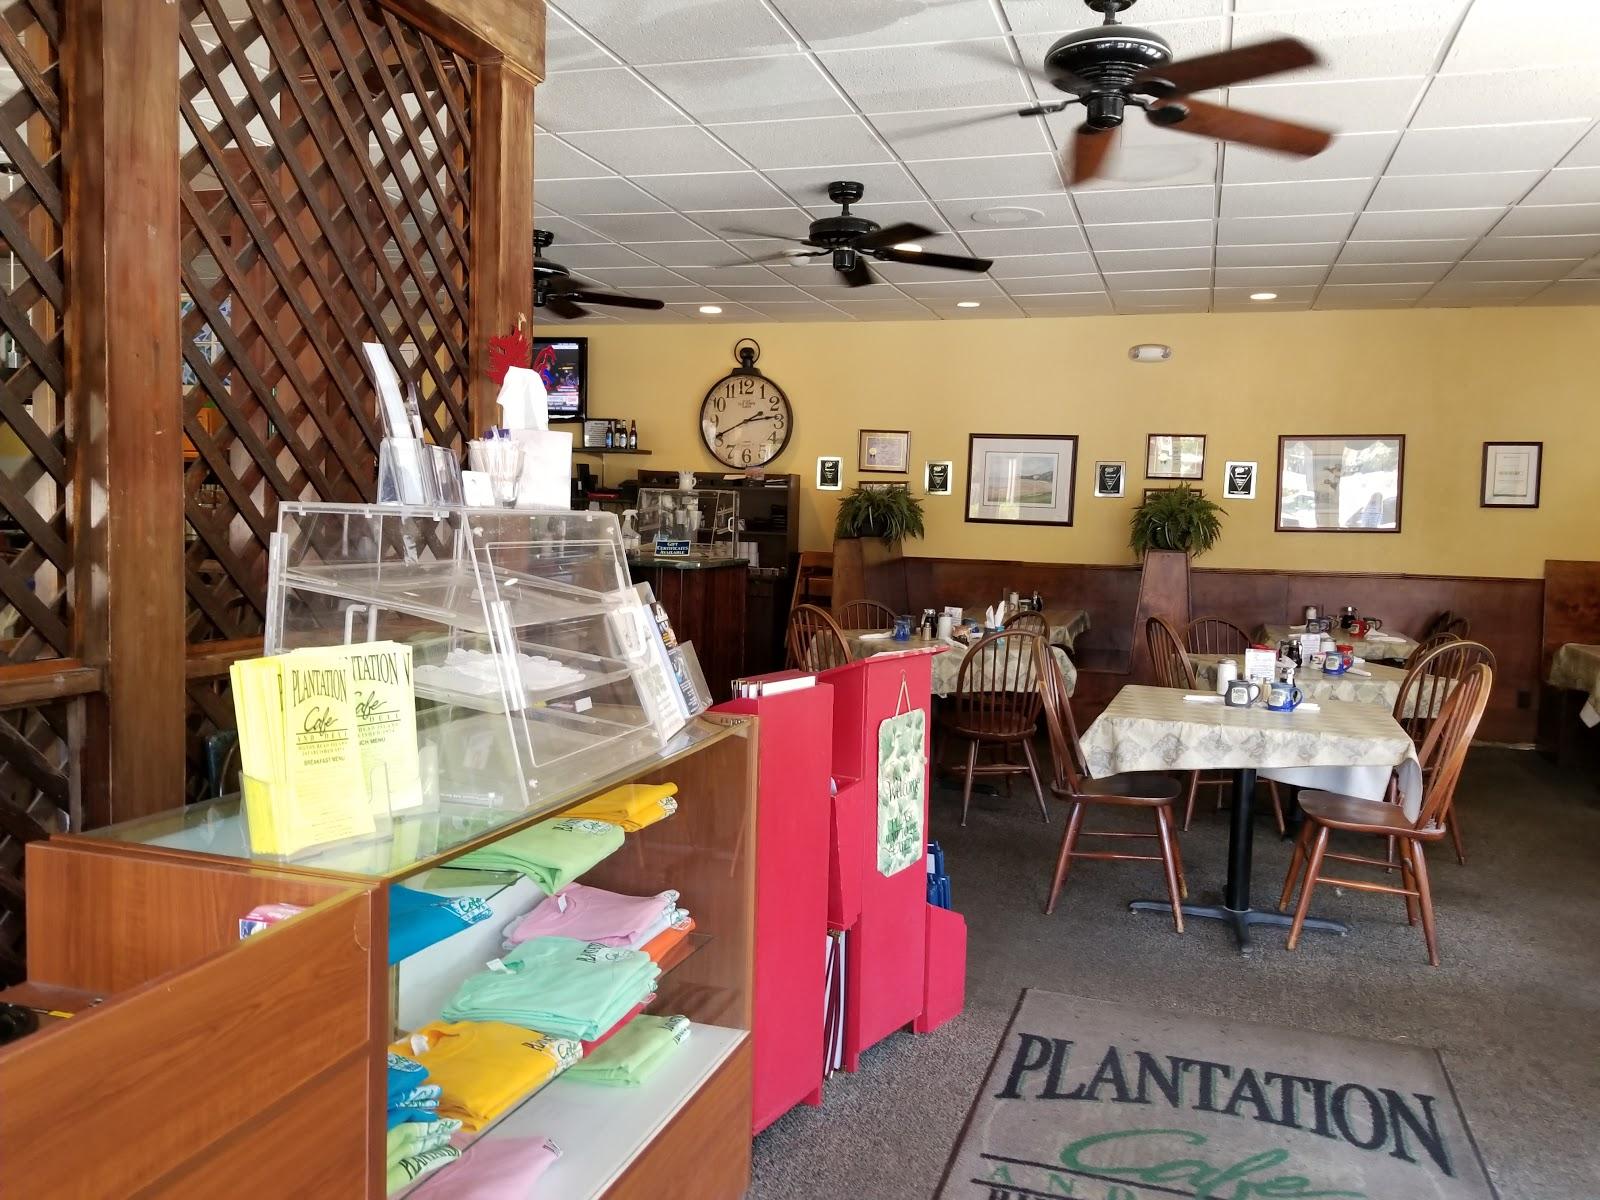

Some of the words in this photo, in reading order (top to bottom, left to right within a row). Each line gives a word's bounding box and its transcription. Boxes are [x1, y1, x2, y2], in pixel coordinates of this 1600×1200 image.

[726, 384, 736, 398] 11
[738, 380, 755, 395] 12
[760, 384, 766, 400] 1
[713, 397, 726, 412] 10
[768, 396, 780, 412] 2
[773, 414, 785, 430] 3
[768, 431, 778, 444] 4
[726, 444, 736, 460] 7
[742, 448, 752, 464] 6
[292, 669, 347, 708] PLANTATION
[304, 706, 338, 736] Cafe
[995, 1032, 1454, 1177] PLANTATION
[1059, 1128, 1368, 1200] Cafe
